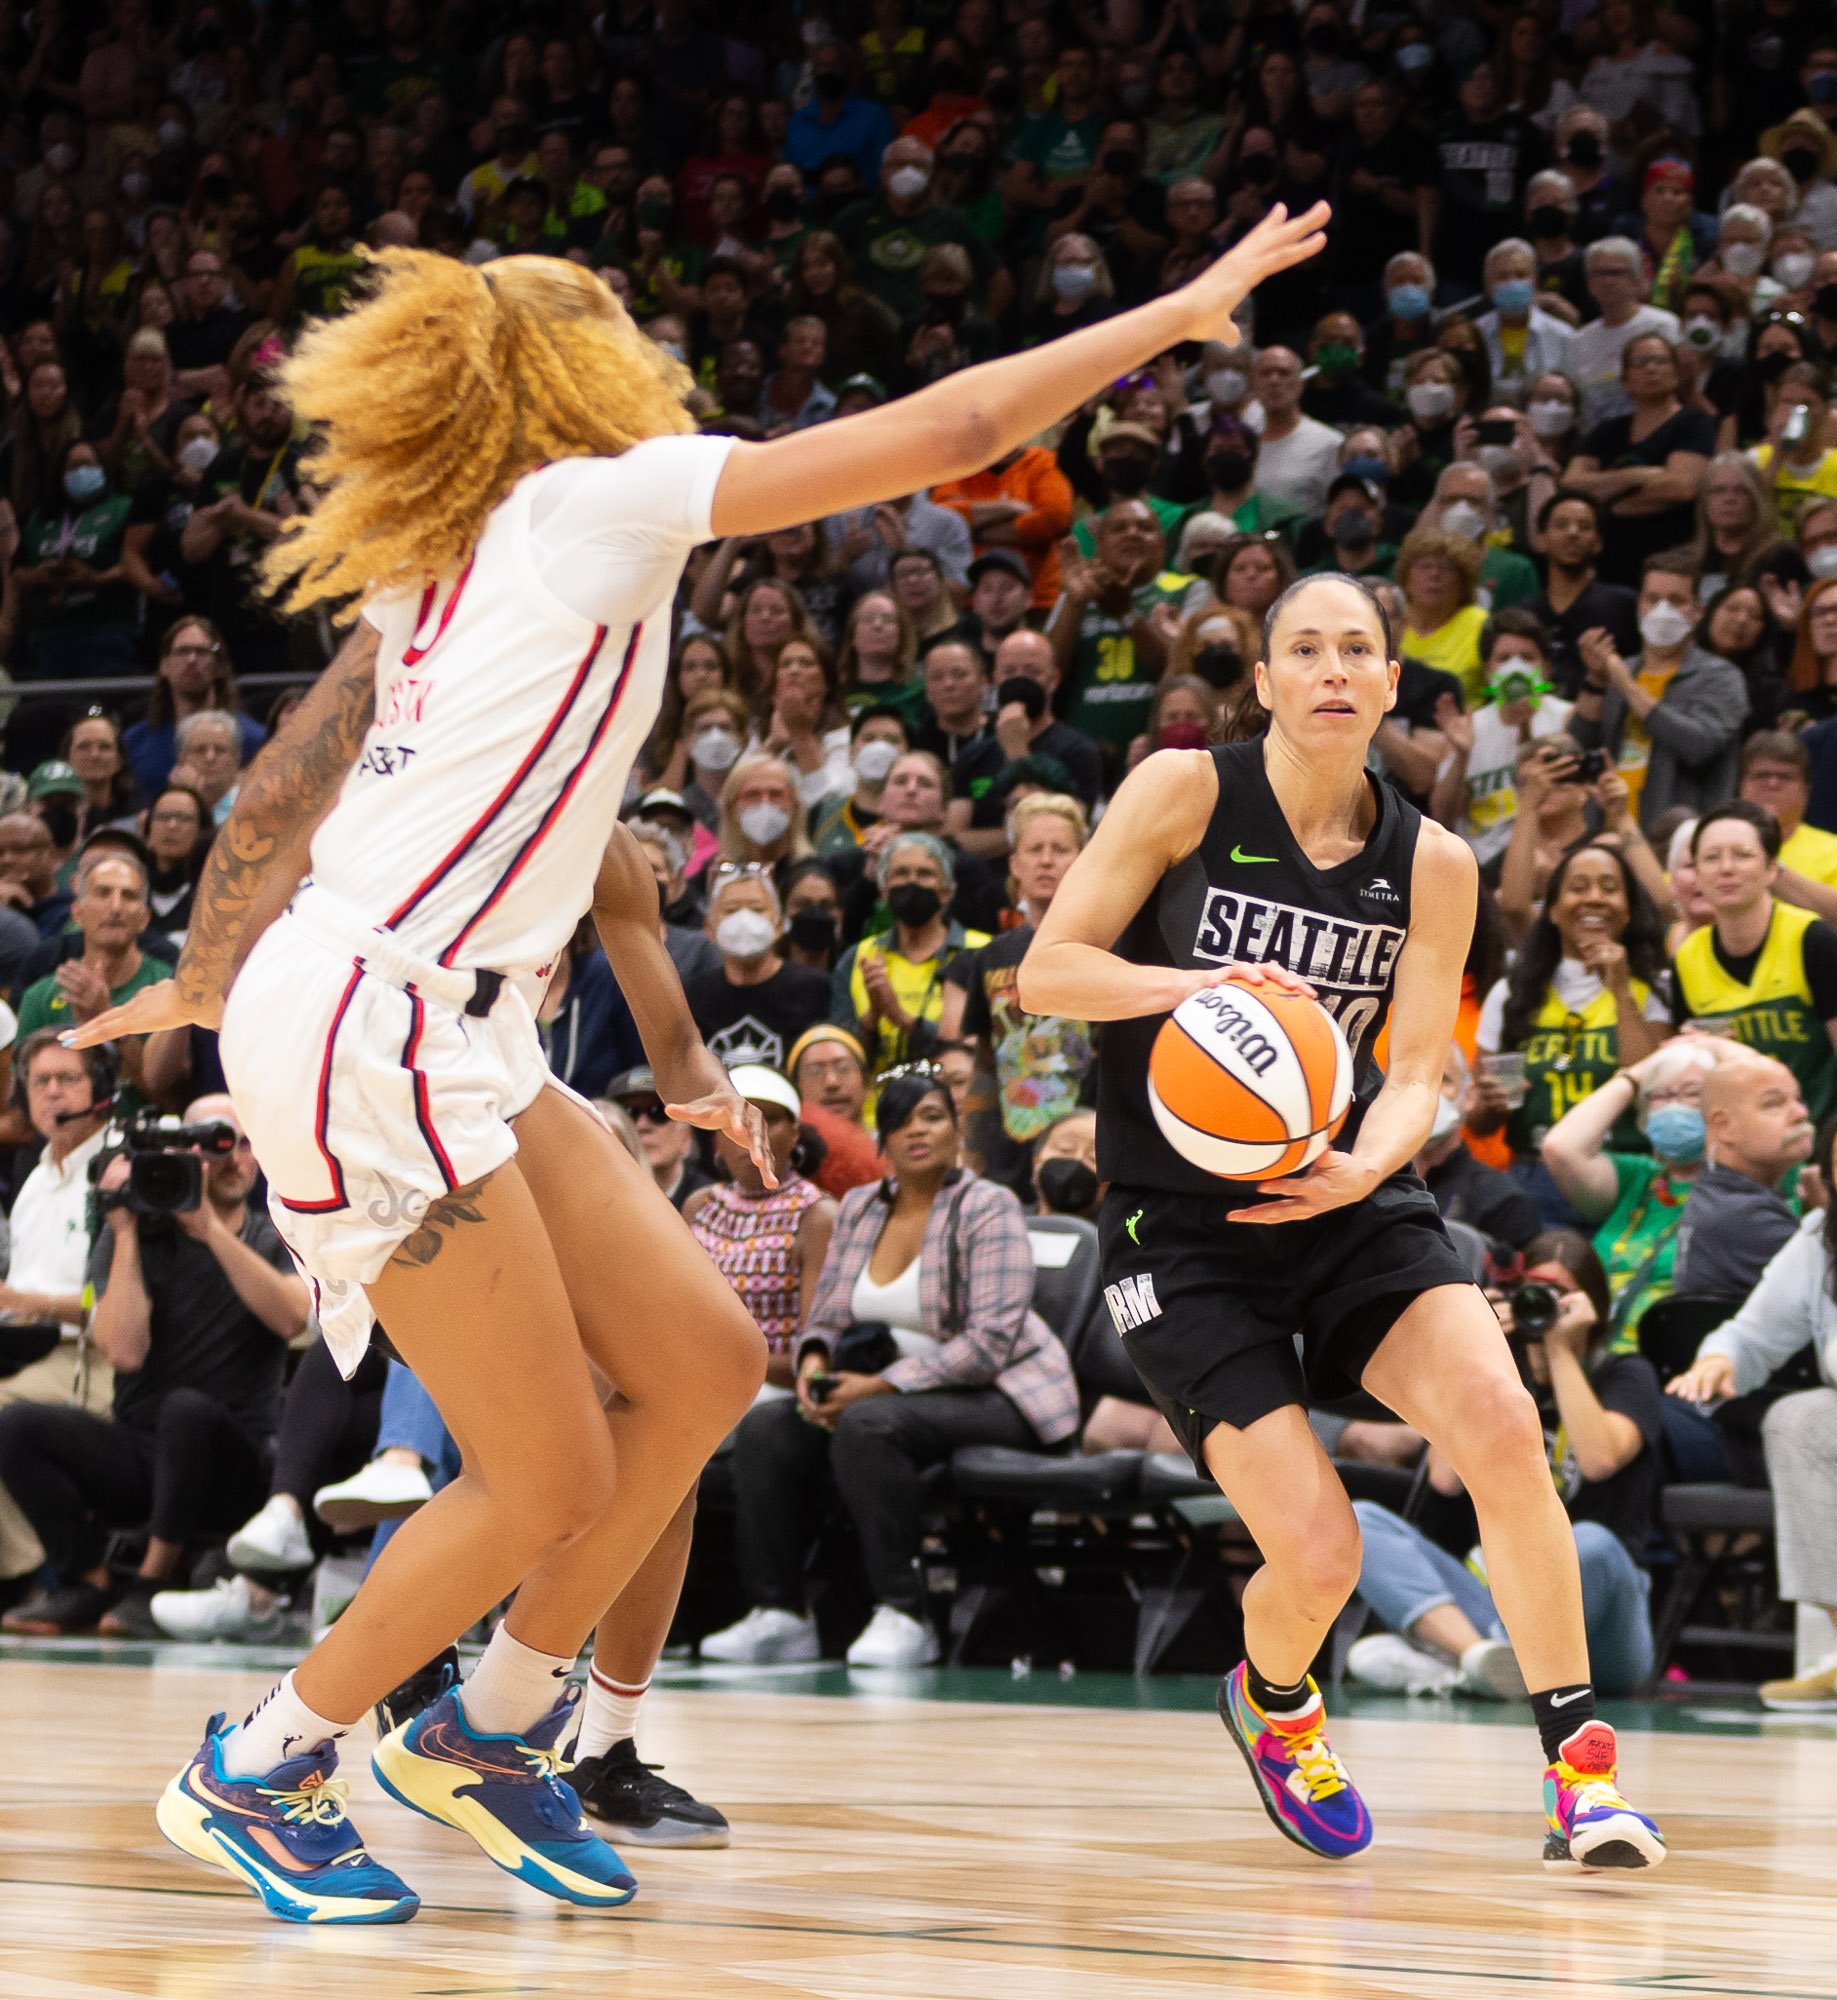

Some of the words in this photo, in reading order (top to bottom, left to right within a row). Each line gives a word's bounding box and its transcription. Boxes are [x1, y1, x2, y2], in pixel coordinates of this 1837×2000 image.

[1360, 889, 1400, 901] SYMETRA
[1200, 894, 1404, 986] SEATTLE
[1195, 988, 1278, 1078] Wilson
[1544, 1071, 1594, 1121] 14
[1104, 1273, 1163, 1337] RM
